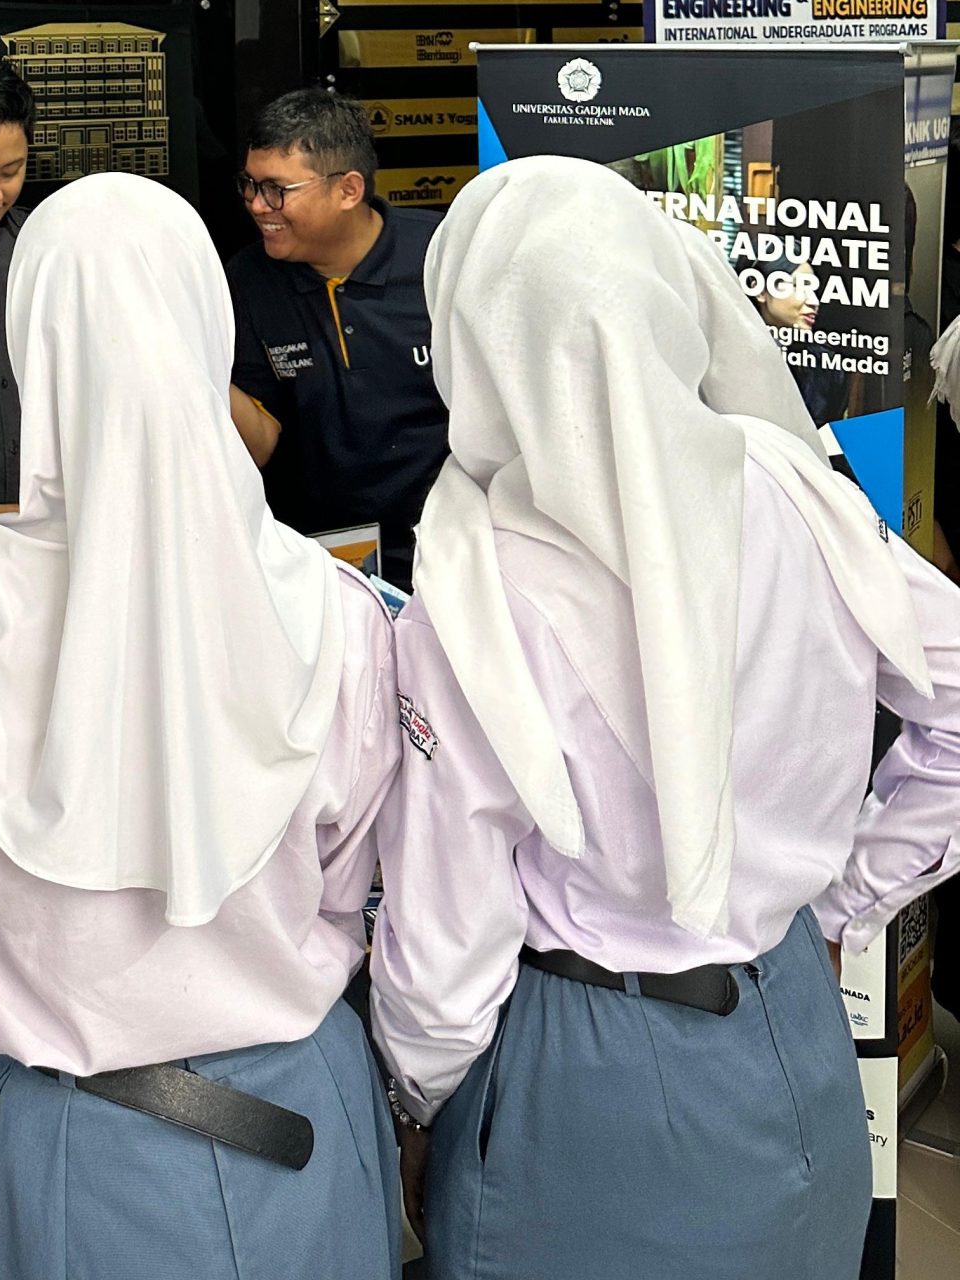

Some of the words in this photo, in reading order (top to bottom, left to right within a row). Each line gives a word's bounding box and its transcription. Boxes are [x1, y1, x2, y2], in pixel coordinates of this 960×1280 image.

[664, 26, 757, 41] INTERNATIONAL
[763, 25, 865, 40] UNDERGRADUATE
[869, 23, 928, 37] PROGRAMS
[512, 103, 573, 115] UNIVERSITAS
[575, 105, 616, 118] GADJAH
[618, 106, 650, 117] MADA
[395, 114, 432, 126] SMAN
[437, 113, 445, 125] 3
[543, 115, 584, 125] FAKULTAS
[586, 116, 615, 126] TEKNIK
[738, 267, 890, 309] OGRAM
[821, 351, 890, 376] Mada
